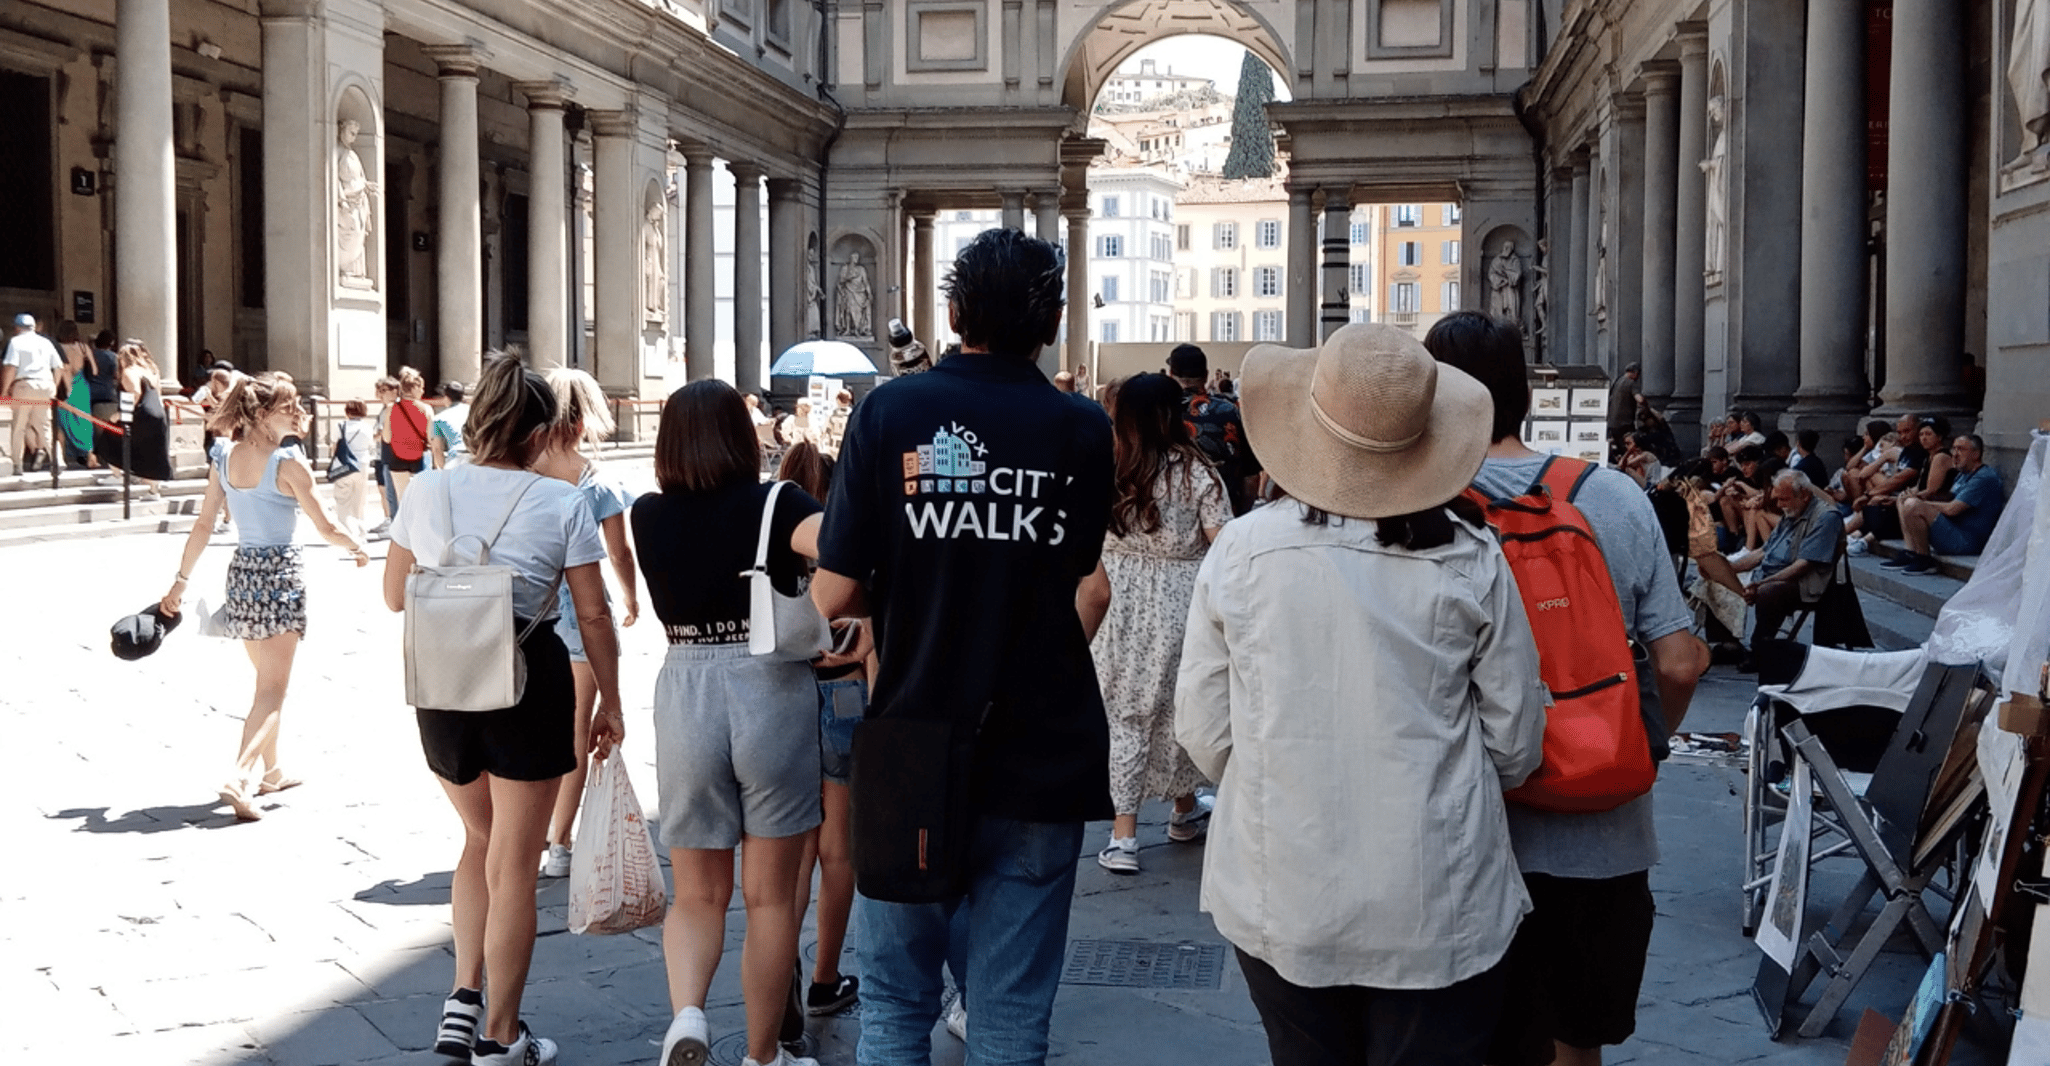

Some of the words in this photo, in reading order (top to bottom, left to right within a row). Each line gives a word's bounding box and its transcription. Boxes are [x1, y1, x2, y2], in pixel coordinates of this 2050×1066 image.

[80, 175, 87, 187] 1
[951, 420, 989, 458] VOX
[989, 467, 1074, 499] CIT
[706, 622, 712, 635] I
[716, 620, 736, 633] DO
